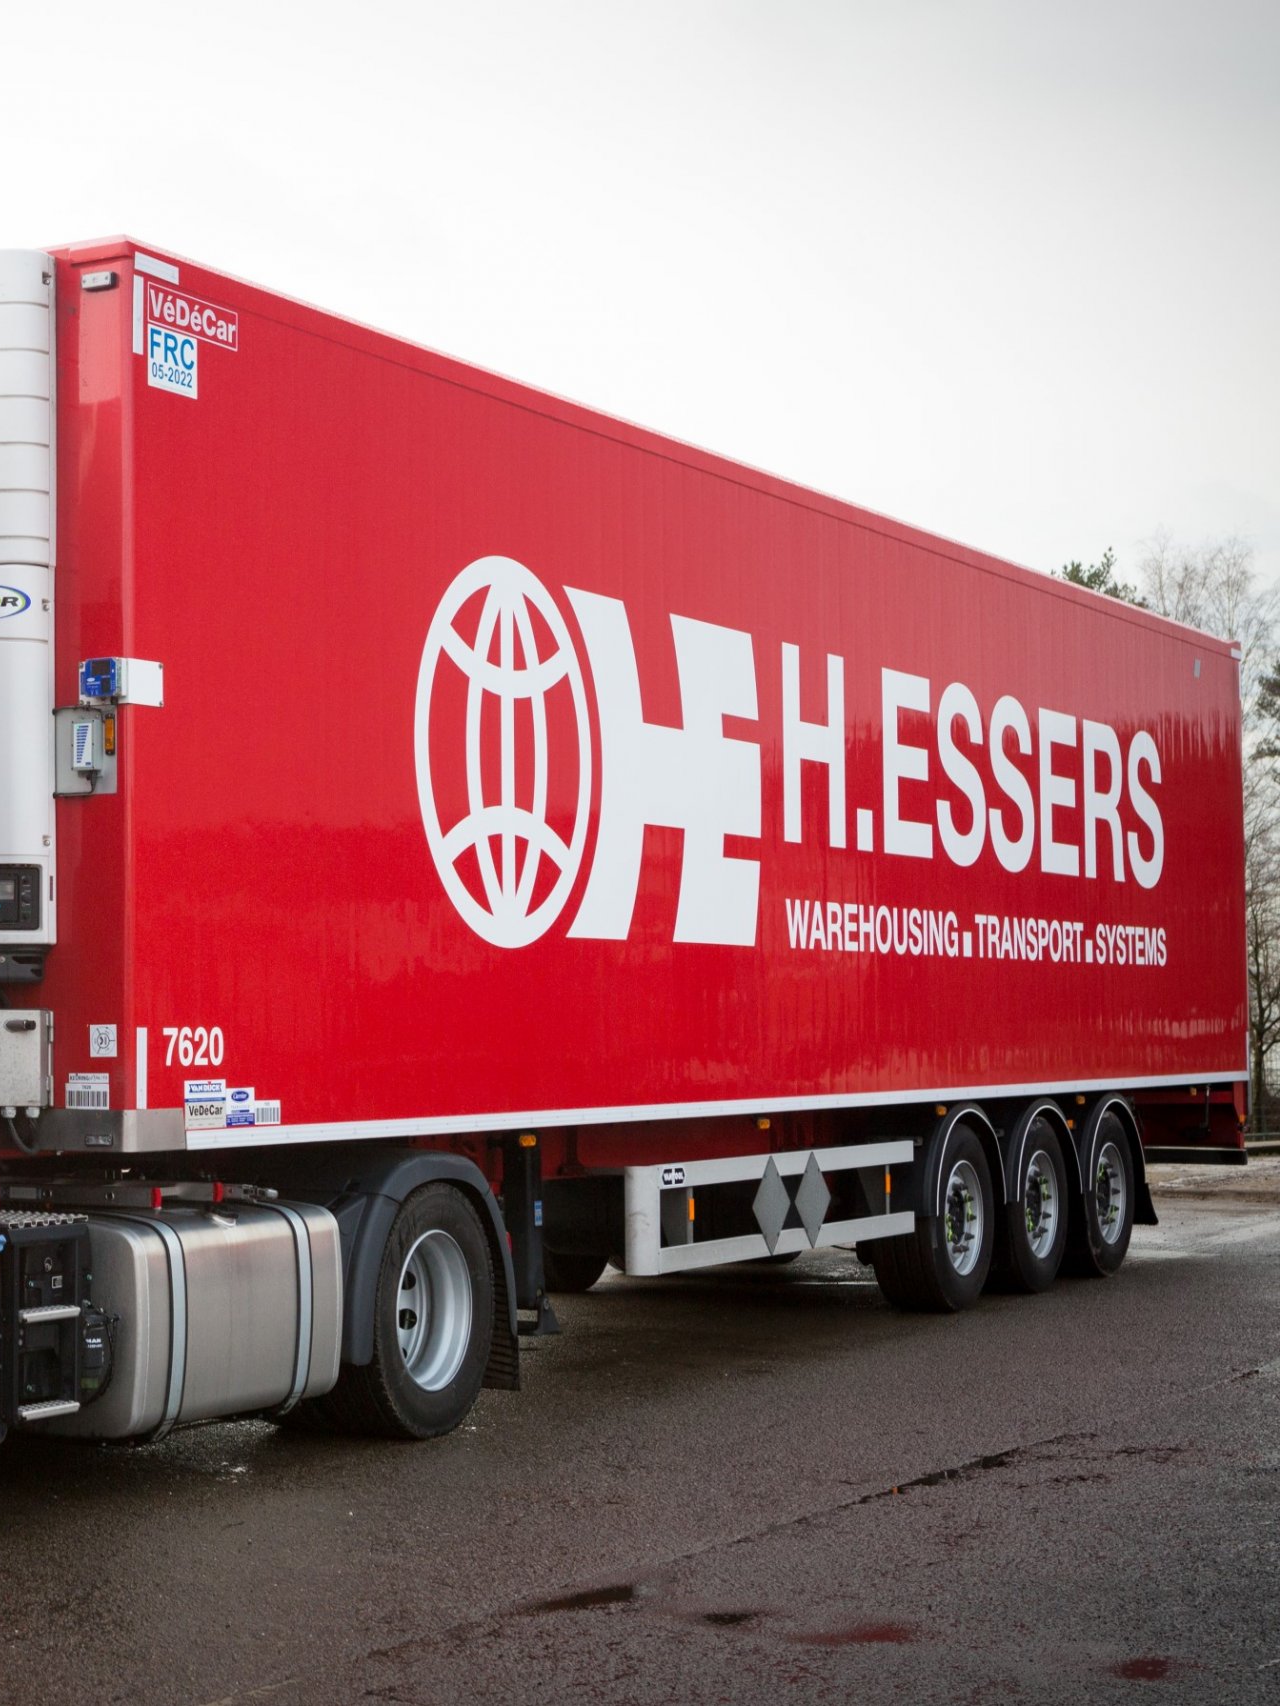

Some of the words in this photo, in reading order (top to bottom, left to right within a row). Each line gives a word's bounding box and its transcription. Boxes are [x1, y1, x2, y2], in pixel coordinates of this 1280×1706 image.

[149, 288, 237, 343] VéDéCar
[150, 327, 195, 371] FRC
[151, 361, 193, 388] 05-2022
[781, 641, 1165, 889] H.ESSERS
[785, 898, 959, 957] WAREHOUSING
[974, 913, 1084, 963] TRANSPORT
[1095, 923, 1167, 967] SYSTEMS
[162, 1026, 224, 1067] 7620
